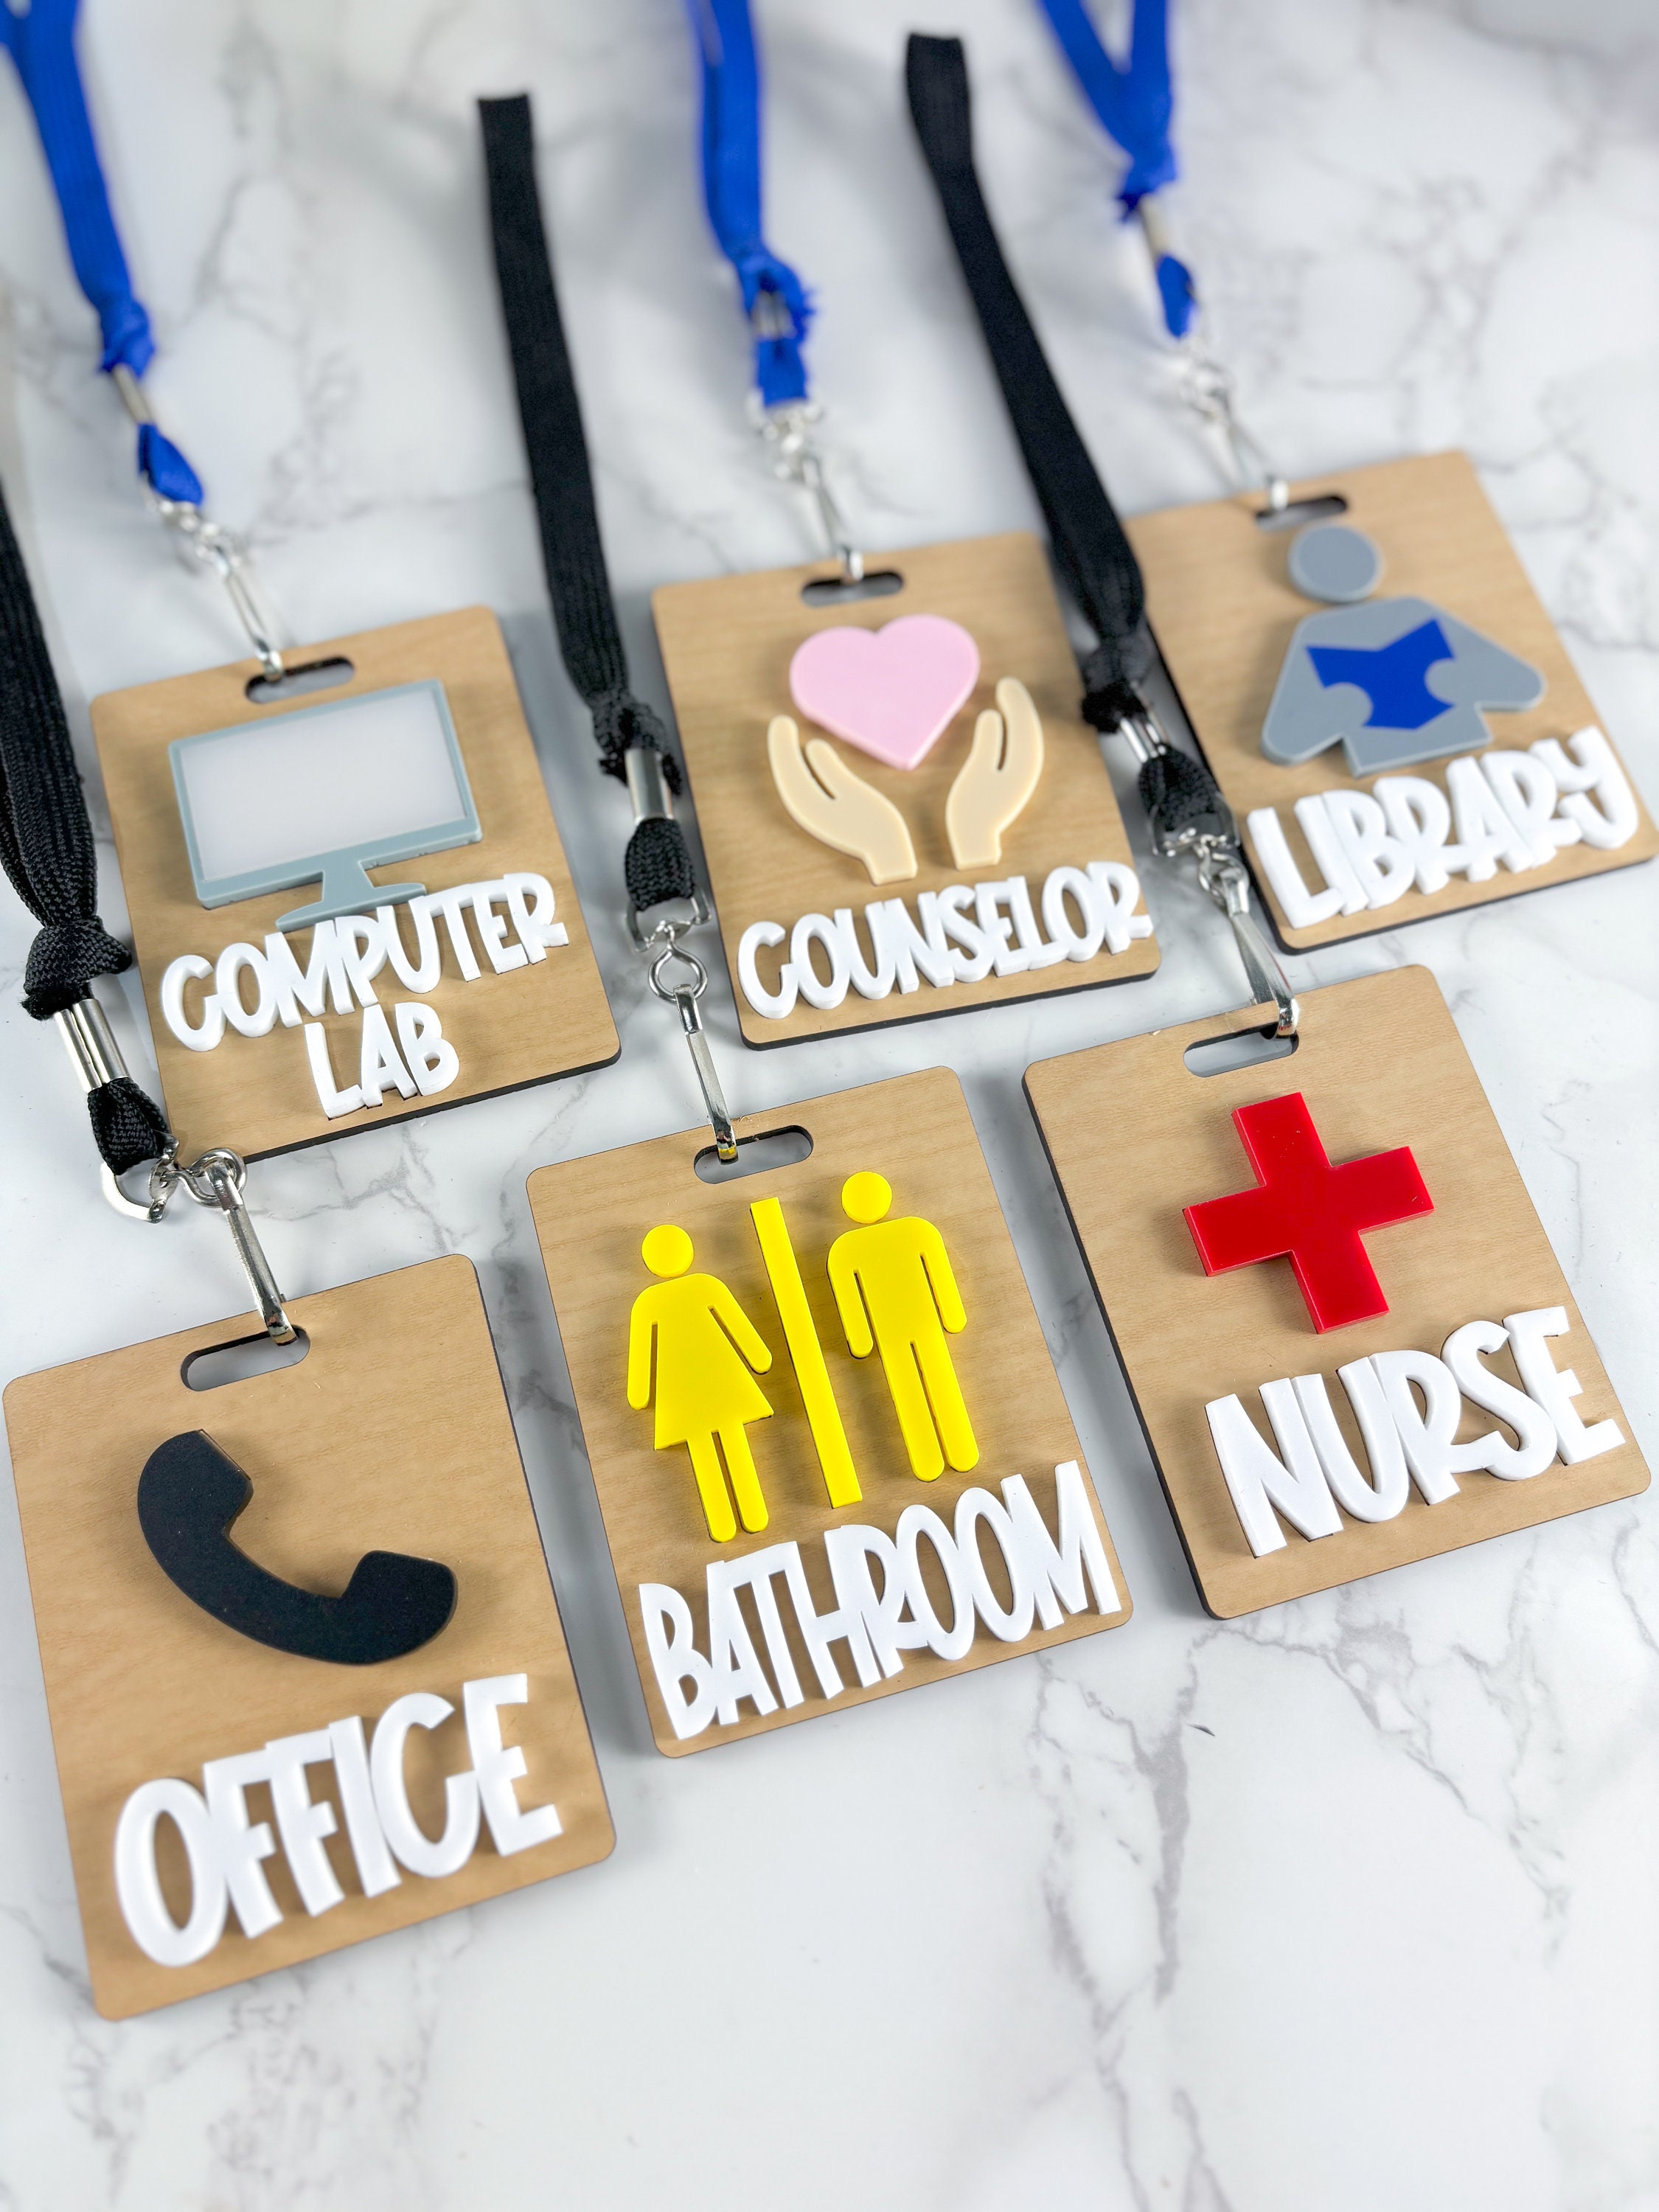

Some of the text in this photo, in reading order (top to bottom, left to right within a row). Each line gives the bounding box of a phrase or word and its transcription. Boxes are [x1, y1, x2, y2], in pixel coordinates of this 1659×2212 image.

[1248, 728, 1638, 928] LIBRARY
[161, 874, 568, 1051] COMPUTER
[738, 862, 1152, 1019] COUNSELOR
[305, 1002, 460, 1119] LAB
[1206, 1308, 1625, 1557] NURSE
[639, 1460, 1121, 1739] BATHROOM
[114, 1673, 562, 1966] OFFICE
